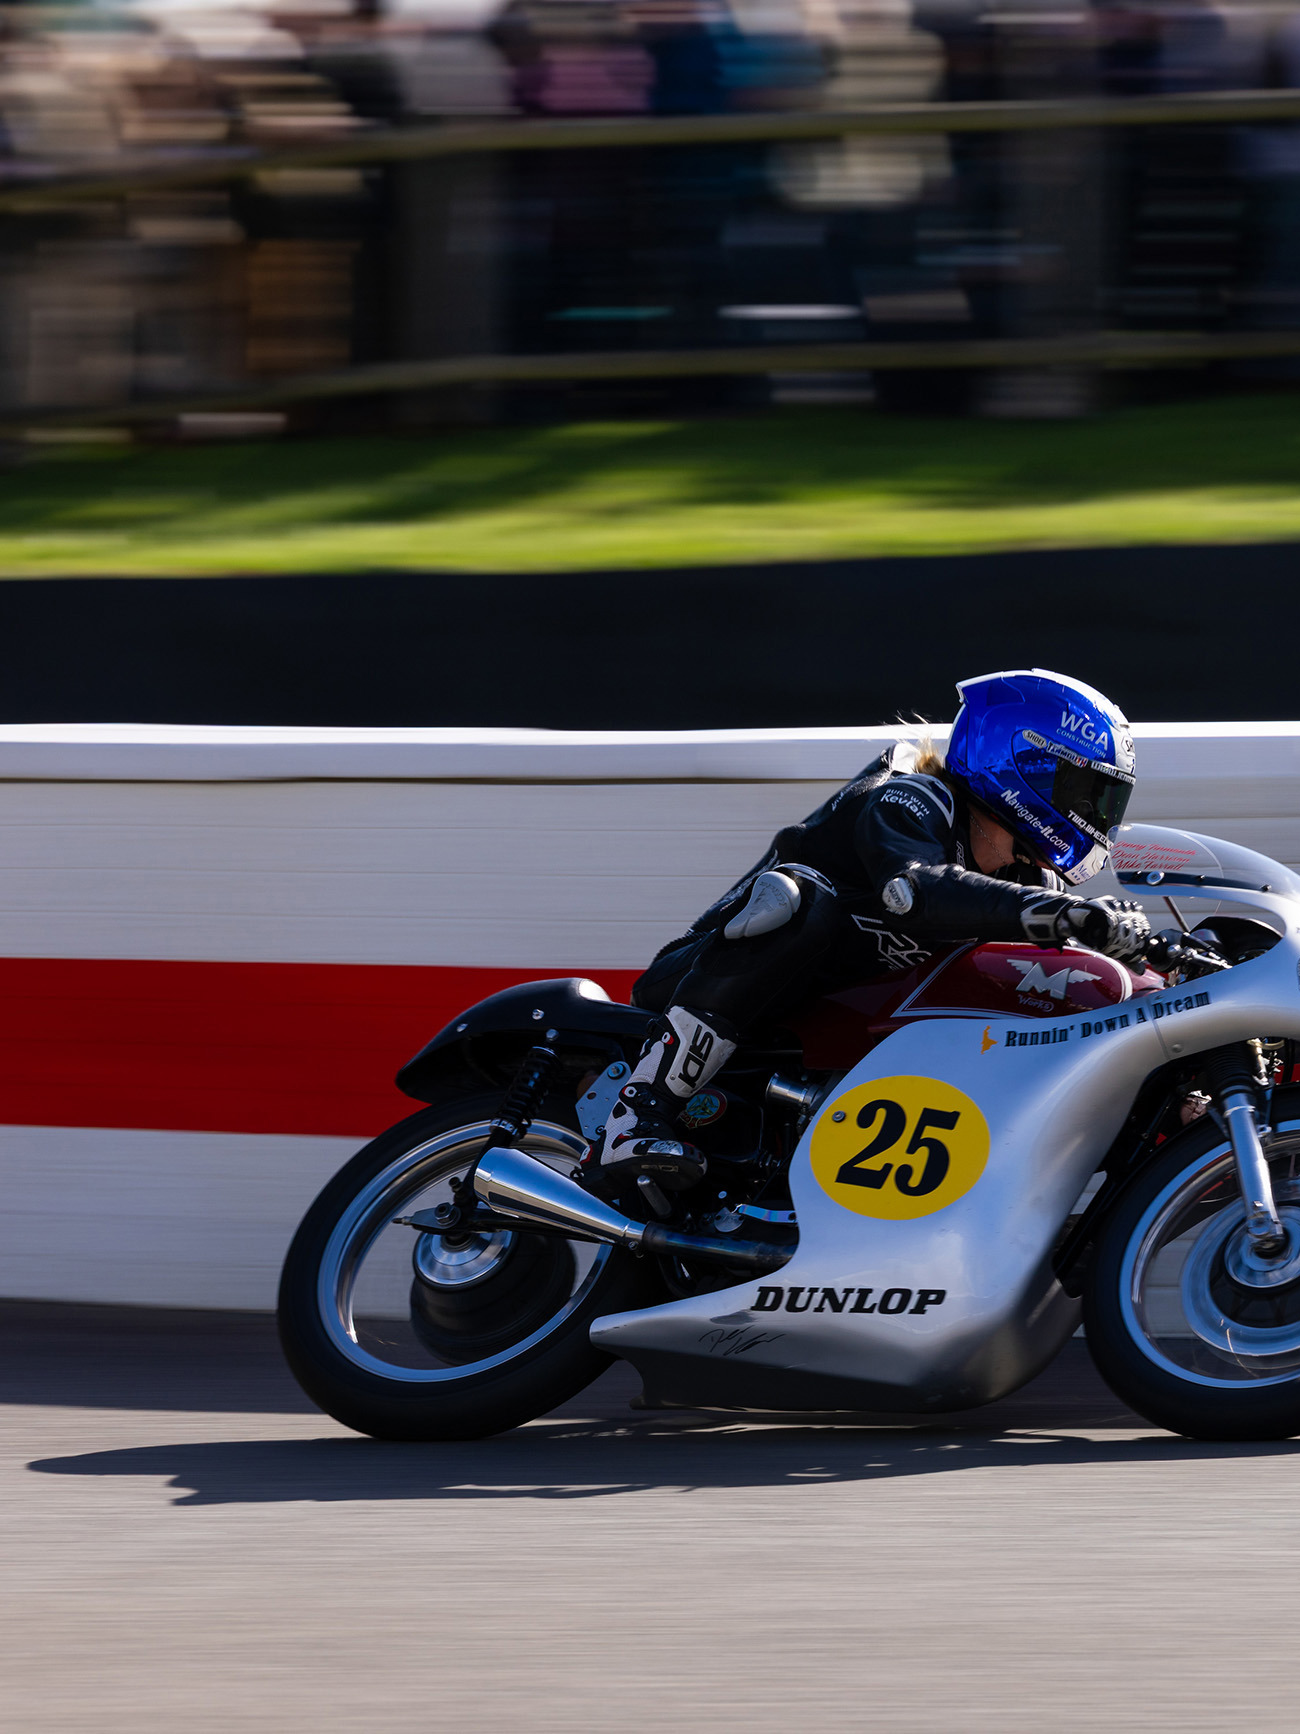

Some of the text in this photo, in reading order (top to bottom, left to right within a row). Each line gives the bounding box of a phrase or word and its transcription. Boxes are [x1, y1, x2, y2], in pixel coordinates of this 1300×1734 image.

[1026, 731, 1046, 747] SHOEI
[1056, 728, 1107, 759] CONSTRUCTION
[1060, 710, 1109, 750] WGA
[910, 795, 930, 815] WITH
[1004, 991, 1211, 1048] Runnin' Down A Dream
[677, 1024, 714, 1089] SIDI
[834, 1098, 961, 1197] 25
[750, 1286, 947, 1315] DUNLOP
